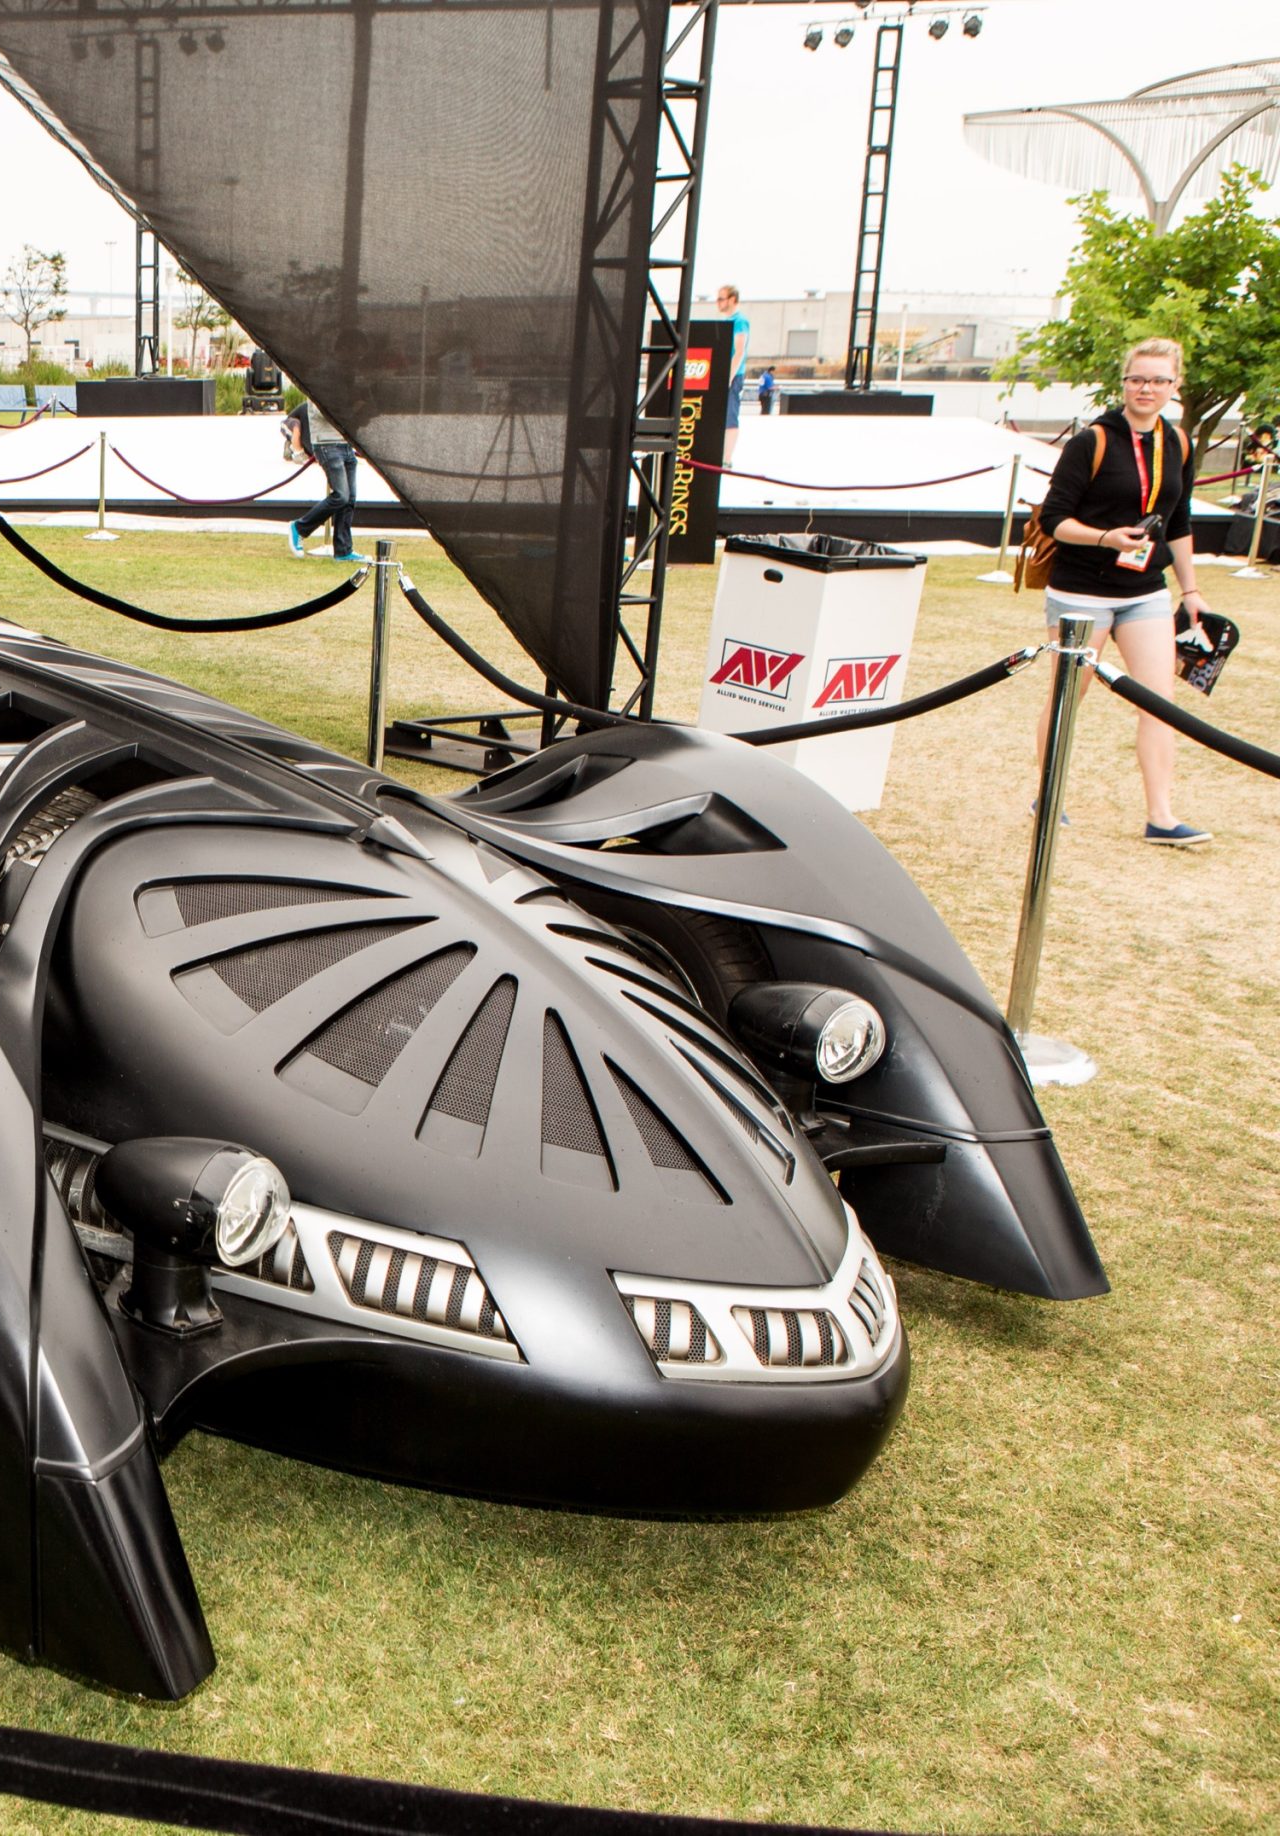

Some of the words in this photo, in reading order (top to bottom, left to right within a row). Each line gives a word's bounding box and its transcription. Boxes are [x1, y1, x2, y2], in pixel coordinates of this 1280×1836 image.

[669, 467, 694, 535] RINGS
[709, 647, 806, 692] AW
[812, 655, 902, 708] AW
[716, 688, 737, 699] ALLIED
[738, 694, 757, 705] WASTE
[758, 699, 786, 713] SERVICES
